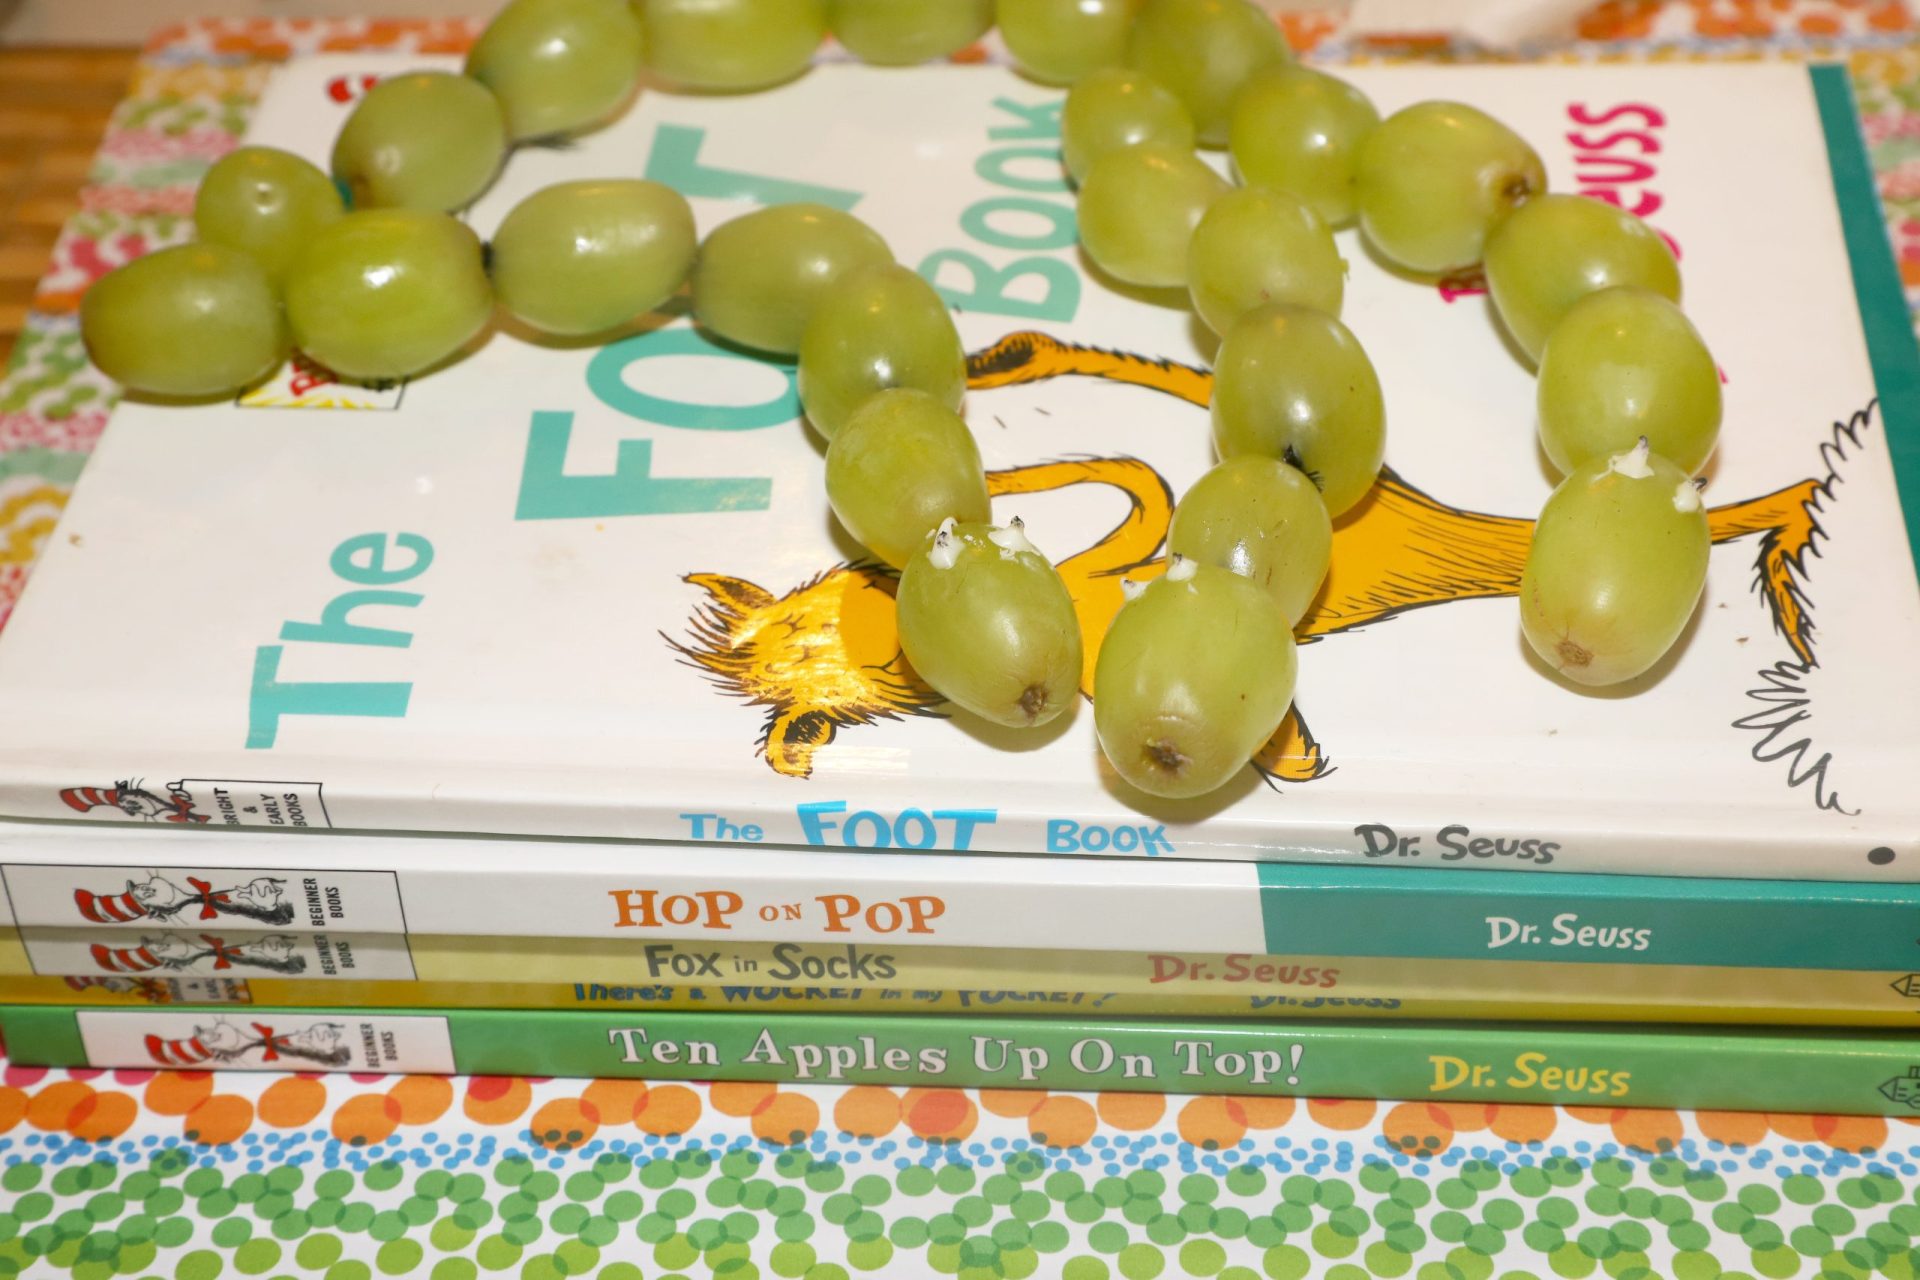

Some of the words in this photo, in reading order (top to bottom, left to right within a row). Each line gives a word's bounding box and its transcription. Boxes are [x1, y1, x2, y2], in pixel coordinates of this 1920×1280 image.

[245, 532, 434, 749] The
[514, 122, 865, 521] FOT
[917, 97, 1081, 323] BOOK
[214, 787, 240, 825] BRIGHT
[243, 806, 258, 814] &
[260, 794, 285, 825] EARLY
[283, 793, 307, 826] BOOKS
[680, 813, 763, 841] The
[797, 800, 998, 851] FOOT
[1047, 820, 1176, 856] BOOK
[1354, 824, 1421, 858] Dr.
[1436, 825, 1561, 864] Seuss
[303, 878, 325, 927] BEGINNER
[325, 887, 344, 918] BOOKS
[608, 889, 743, 929] HOP
[759, 903, 801, 922] ON
[815, 895, 946, 934] POP
[1485, 916, 1541, 949] Dr.
[1550, 914, 1651, 951] Seuss
[335, 942, 355, 968] BOOKS
[644, 945, 724, 977] Fox
[734, 954, 758, 972] in
[767, 943, 897, 980] Socks
[1148, 955, 1214, 984] Dr.
[1223, 953, 1340, 988] Seuss
[360, 1023, 381, 1068] BEGINNER
[380, 1031, 399, 1061] BOOKS
[608, 1027, 721, 1067] Ten
[739, 1028, 949, 1080] Apples
[970, 1035, 1050, 1081] Up
[1069, 1038, 1157, 1079] On
[1173, 1039, 1305, 1086] Top!
[1428, 1056, 1496, 1093] Dr.
[1506, 1051, 1632, 1098] Seuss
